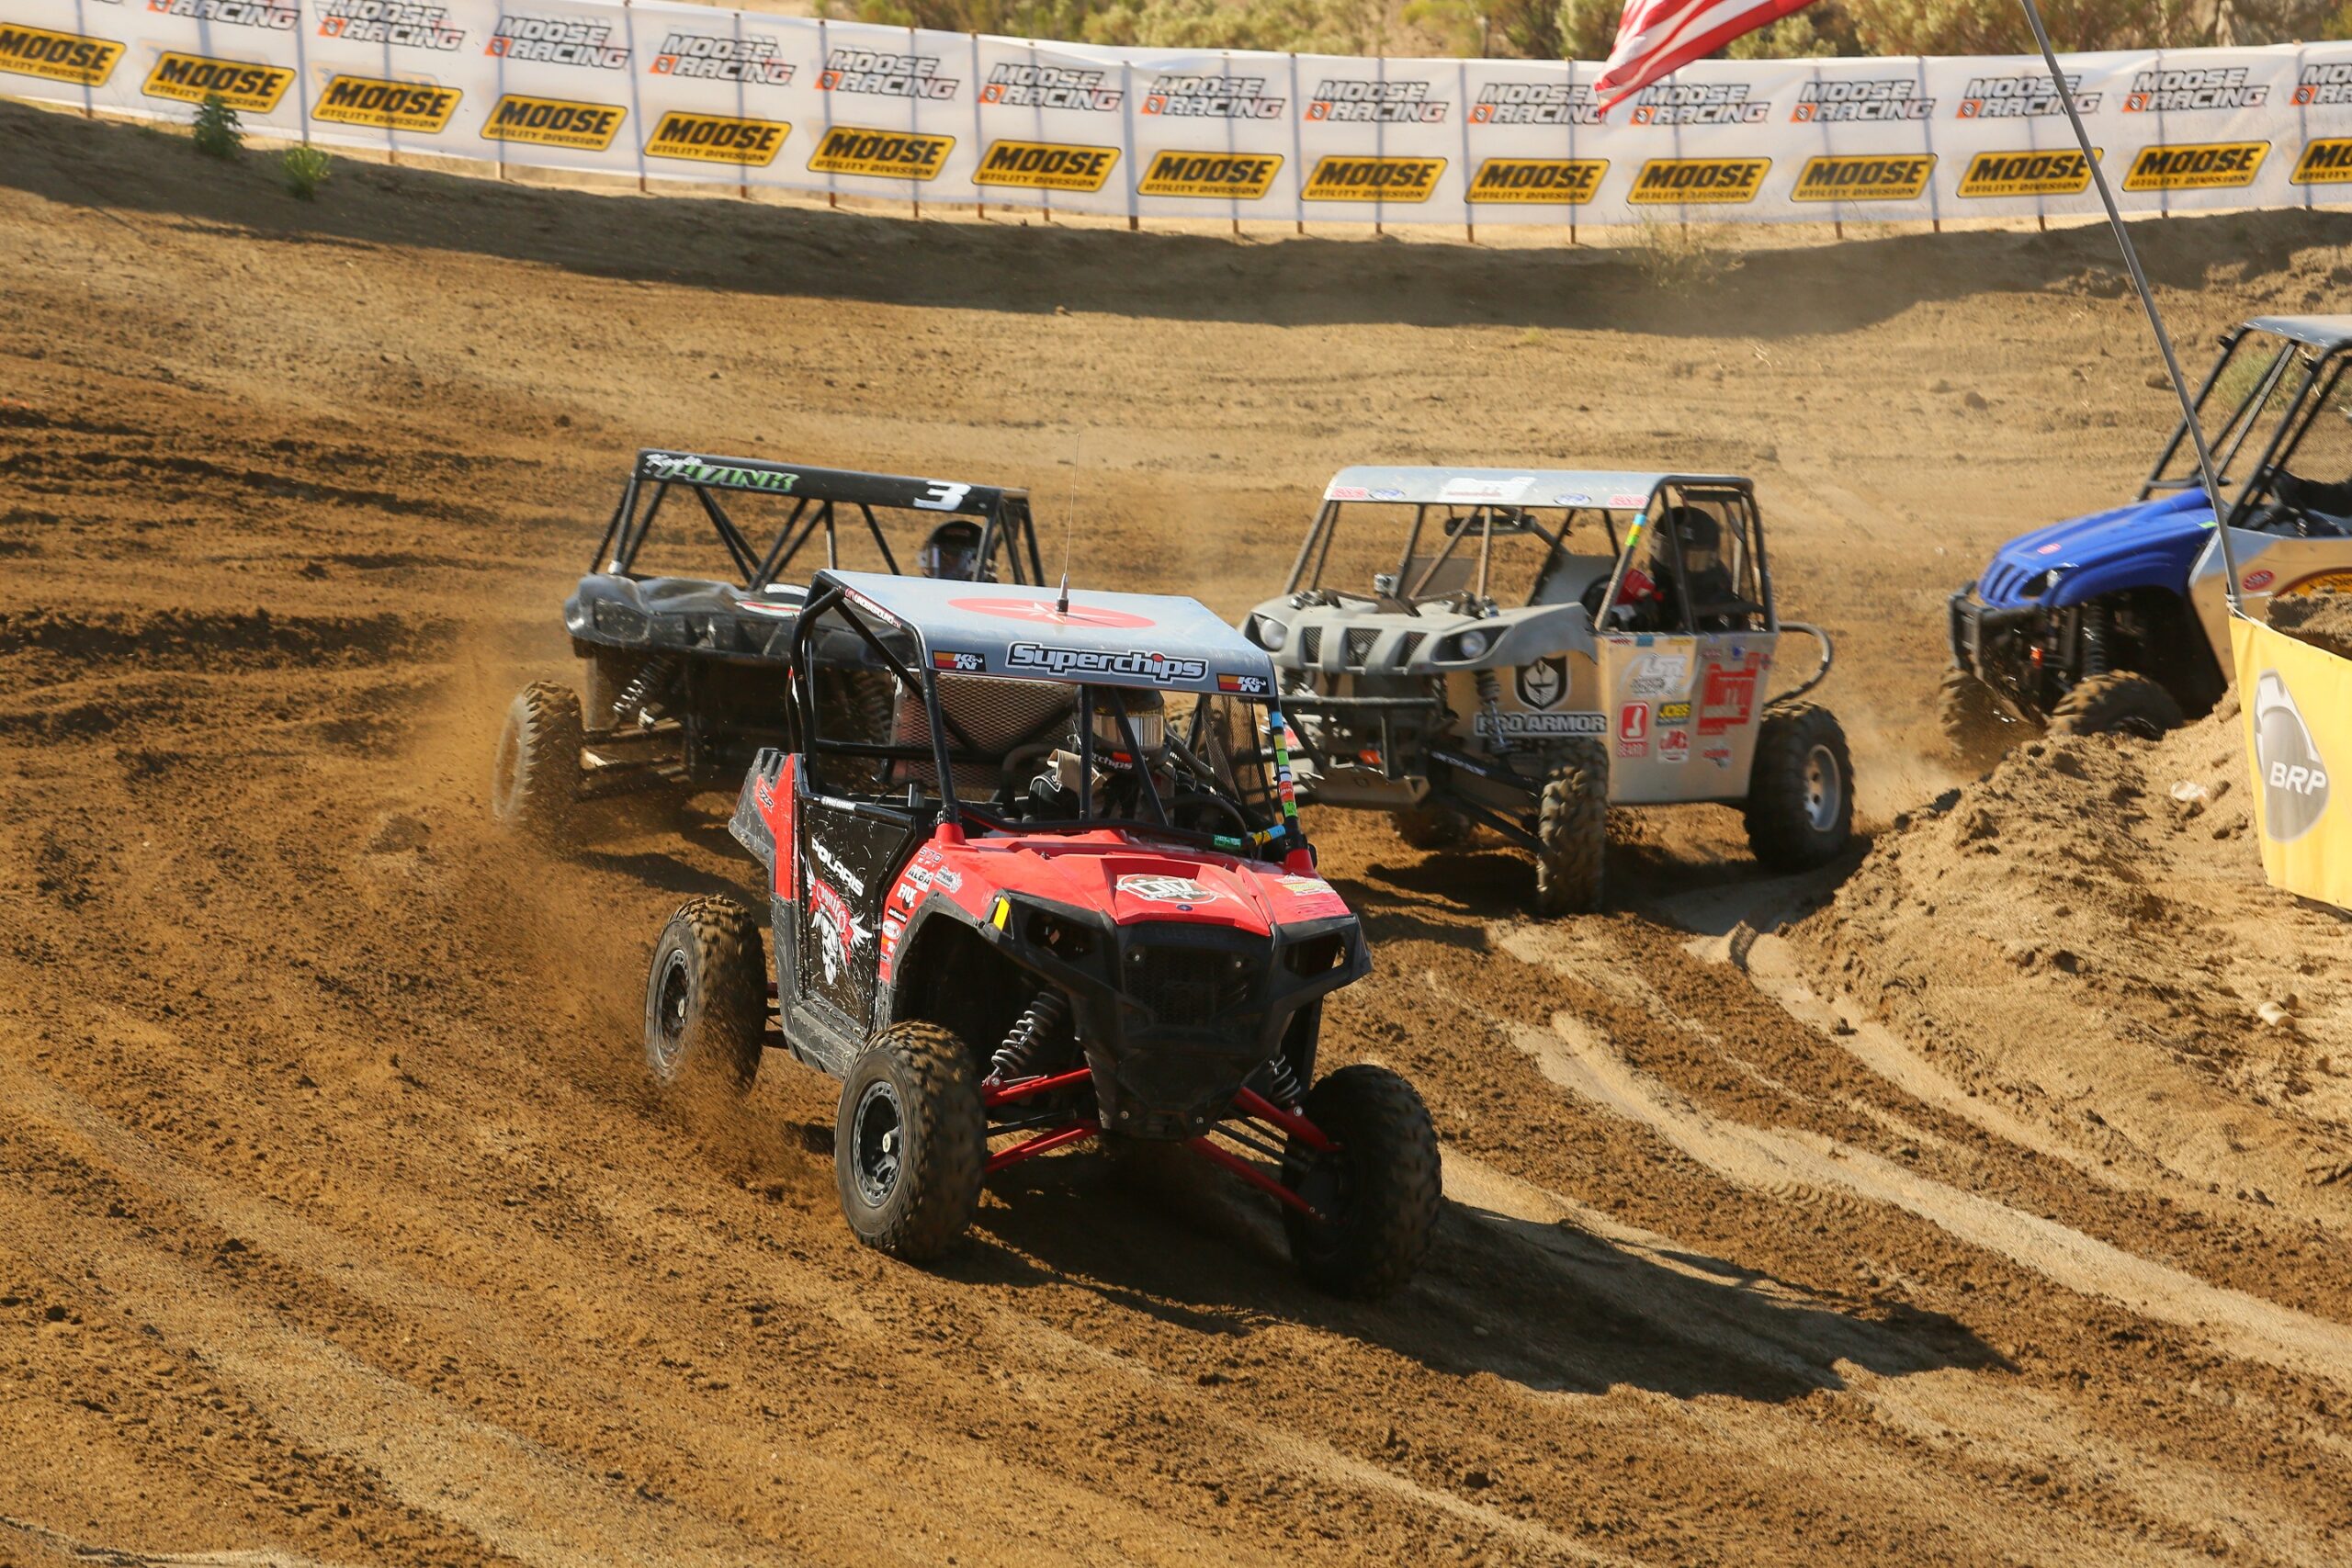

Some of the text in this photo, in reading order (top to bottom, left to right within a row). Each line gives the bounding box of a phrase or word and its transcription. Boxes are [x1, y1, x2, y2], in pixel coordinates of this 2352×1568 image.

[169, 0, 300, 30] RACING
[341, 18, 466, 51] RACING
[495, 16, 612, 45] MOOSE
[0, 29, 115, 71] MOOSE
[509, 39, 631, 69] RACING
[660, 34, 778, 61] MOOSE
[0, 59, 32, 71] ILITY
[673, 56, 797, 85] RACING
[825, 50, 939, 76] MOOSE
[156, 58, 284, 97] MOOSE
[838, 72, 959, 100] RACING
[989, 63, 1105, 90] MOOSE
[1149, 76, 1265, 98] MOOSE
[2132, 67, 2248, 93] MOOSE
[205, 94, 268, 107] ISION
[326, 82, 453, 118] MOOSE
[1000, 85, 1124, 111] RACING
[1314, 81, 1429, 101] MOOSE
[1477, 84, 1590, 105] MOOSE
[1638, 84, 1750, 106] MOOSE
[1800, 80, 1915, 102] MOOSE
[2146, 85, 2269, 111] RACING
[497, 101, 616, 135] MOOSE
[1163, 95, 1285, 118] RACING
[1328, 102, 1449, 123] RACING
[1651, 102, 1771, 125] RACING
[1813, 99, 1936, 121] RACING
[659, 118, 783, 152] MOOSE
[822, 133, 945, 165] MOOSE
[988, 147, 1110, 176] MOOSE
[2137, 147, 2260, 176] MOOSE
[1152, 158, 1274, 185] MOOSE
[1316, 163, 1437, 187] MOOSE
[1479, 165, 1600, 188] MOOSE
[1641, 164, 1762, 188] MOOSE
[1806, 161, 1928, 186] MOOSE
[1970, 155, 2087, 182] MOOSE
[913, 479, 972, 512] 3
[1010, 643, 1205, 682] Superchips
[1526, 715, 1607, 733] ARMOR
[2269, 761, 2327, 796] BRP
[811, 836, 865, 897] POLARIS
[919, 847, 943, 863] 570
[897, 883, 917, 908] FOX
